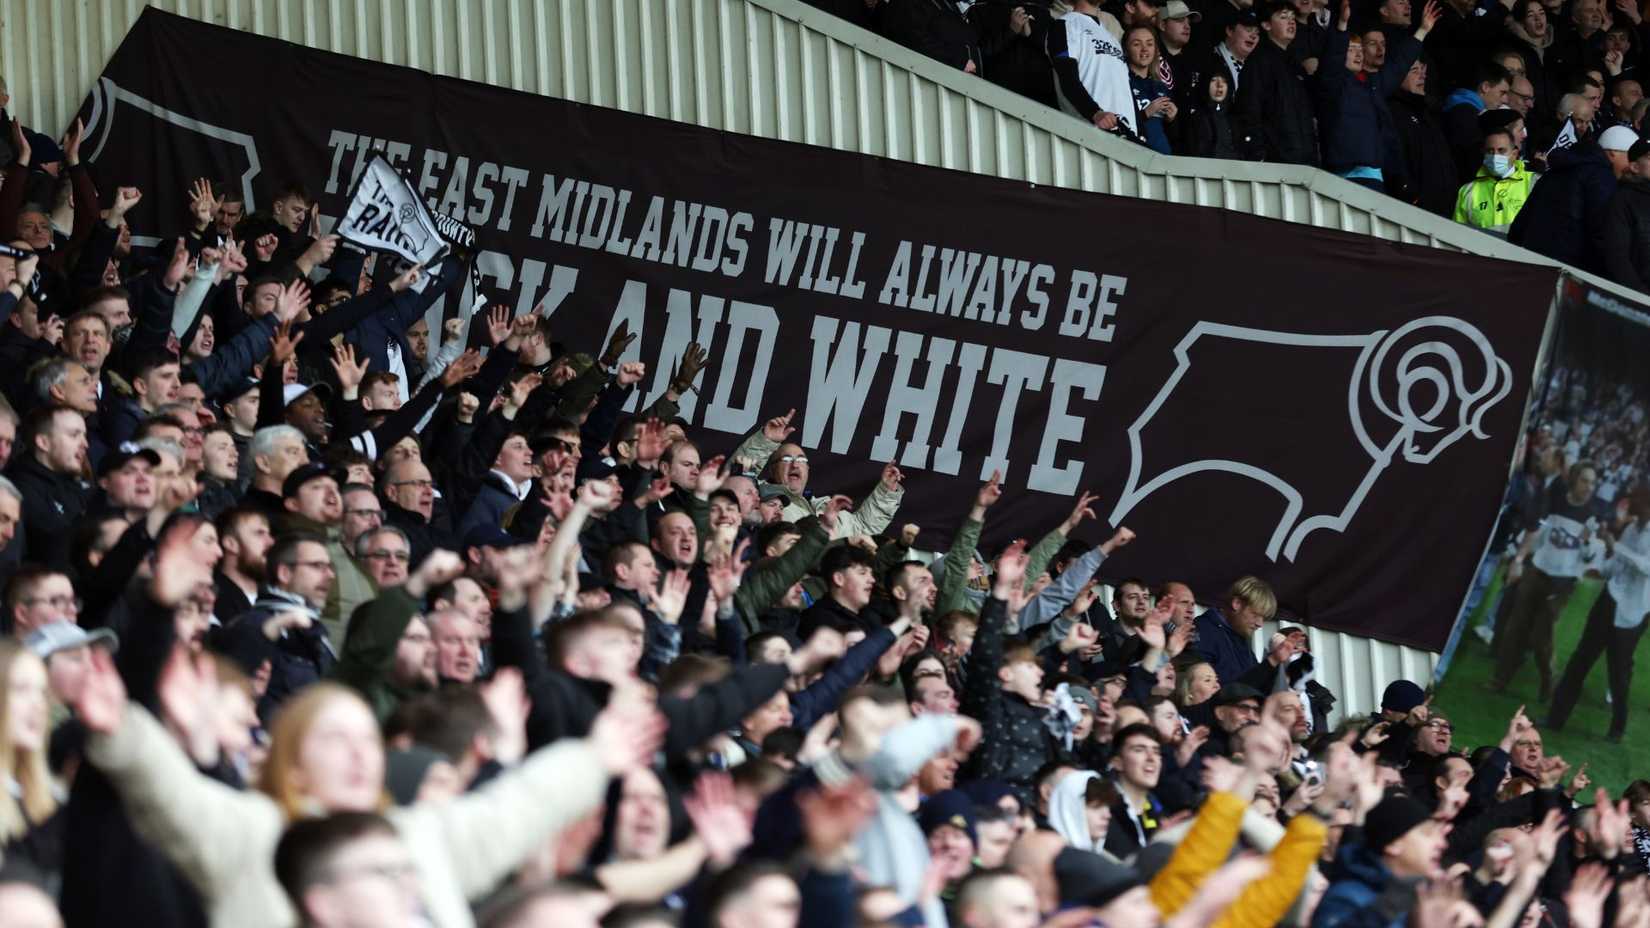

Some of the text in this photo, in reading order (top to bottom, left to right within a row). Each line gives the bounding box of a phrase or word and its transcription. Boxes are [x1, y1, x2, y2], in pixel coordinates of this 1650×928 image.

[418, 149, 530, 232] EAST
[530, 173, 755, 280] MIDLANDS
[763, 217, 867, 300] WILL
[878, 239, 1056, 332] ALWAYS
[1058, 269, 1128, 342] BE
[597, 279, 780, 436] AND
[801, 314, 1107, 496] WHITE
